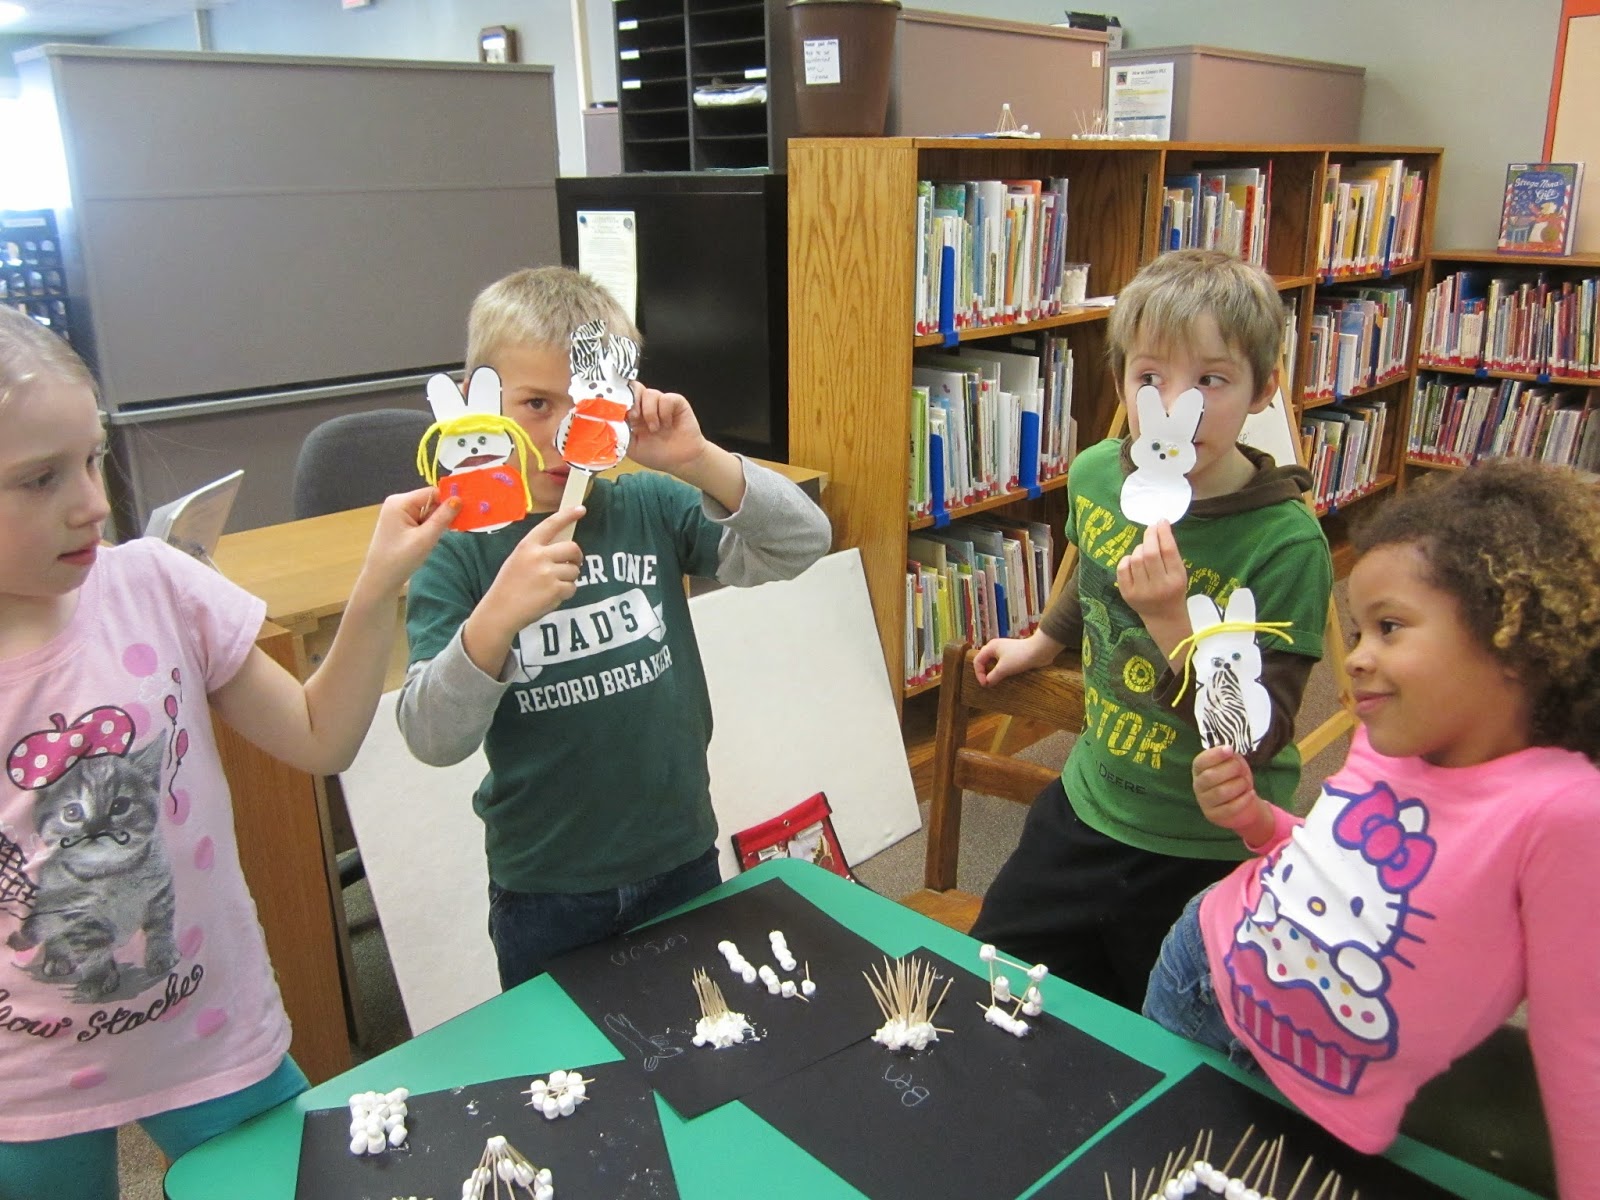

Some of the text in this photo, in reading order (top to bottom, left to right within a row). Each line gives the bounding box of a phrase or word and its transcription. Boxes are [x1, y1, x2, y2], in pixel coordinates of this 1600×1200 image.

[612, 552, 658, 586] ONE
[540, 600, 639, 657] DAD'S
[515, 645, 673, 715] RECORD BREAKER
[1098, 762, 1146, 795] DEERE
[77, 964, 204, 1043] Stache
